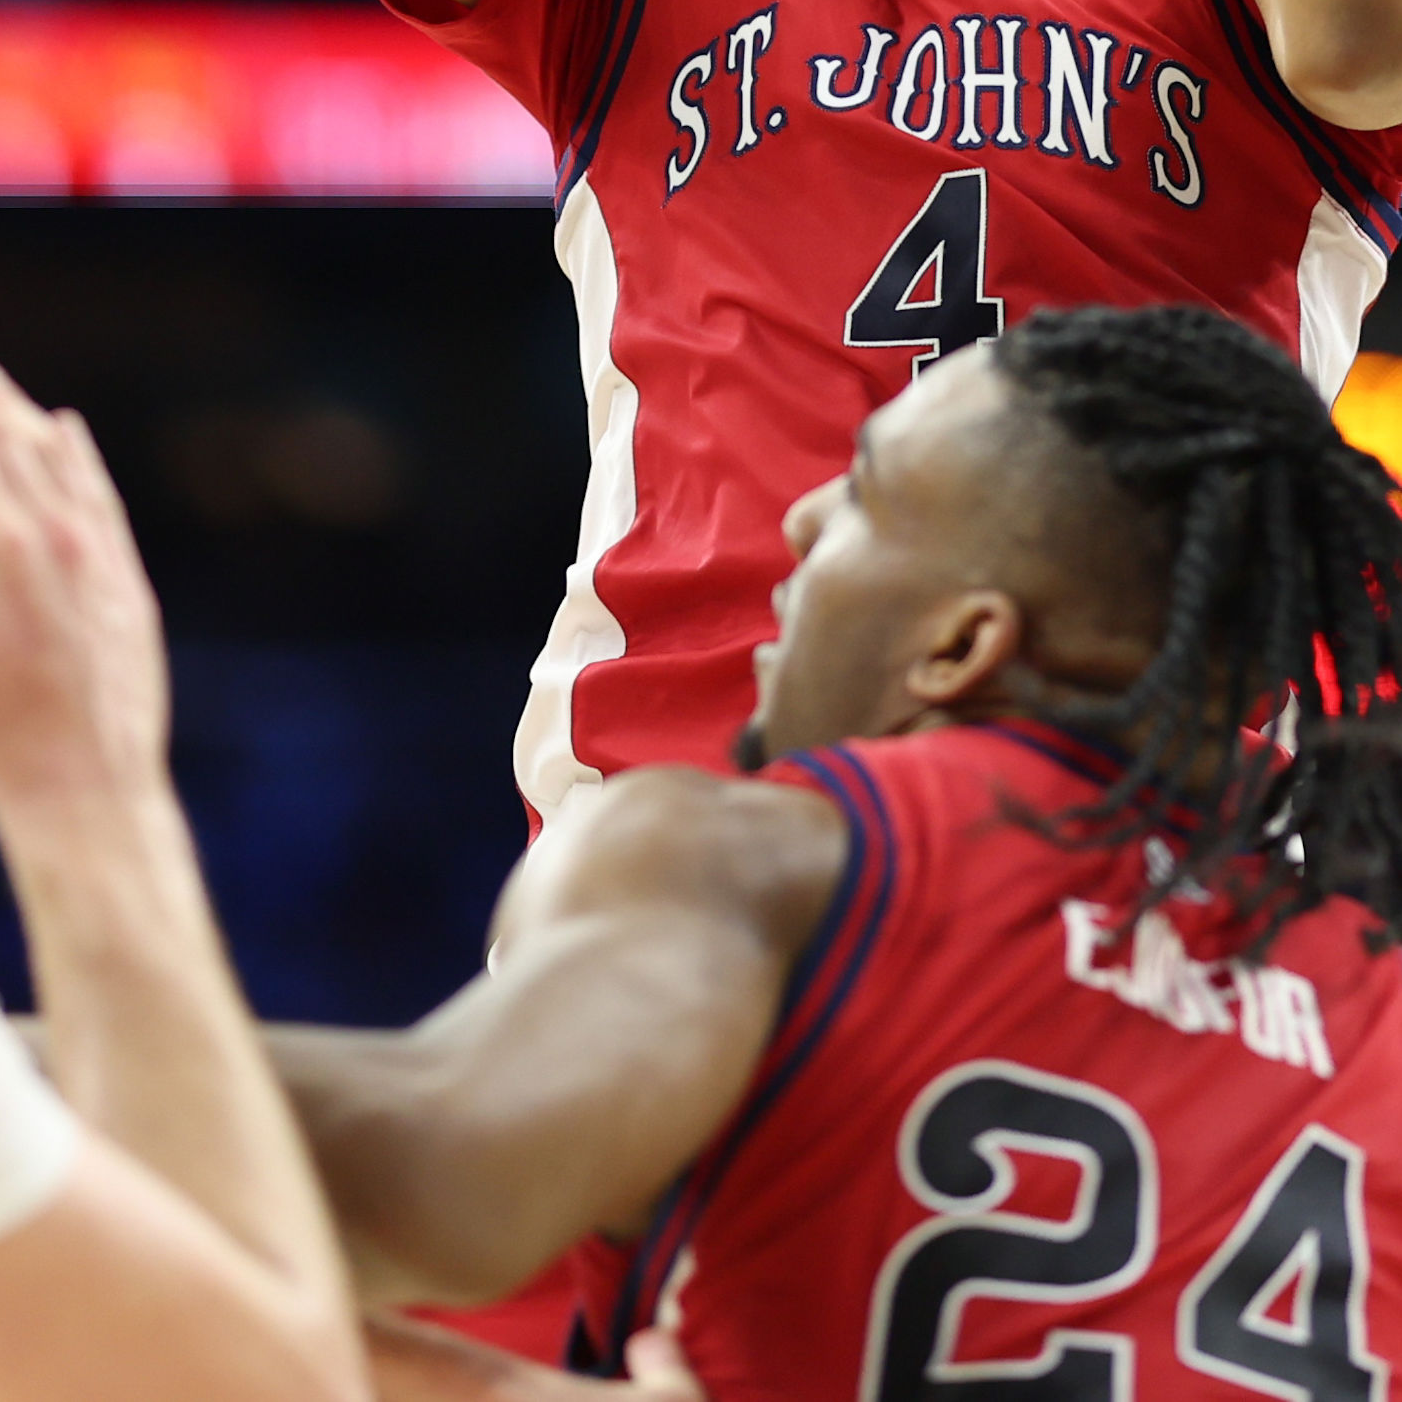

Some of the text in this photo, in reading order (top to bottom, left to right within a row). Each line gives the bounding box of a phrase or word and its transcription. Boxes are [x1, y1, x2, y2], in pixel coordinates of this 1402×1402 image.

[660, 1, 788, 208] ST.
[808, 13, 1208, 210] JOHN'S
[843, 166, 1005, 390] 4
[858, 1056, 1393, 1402] 24
